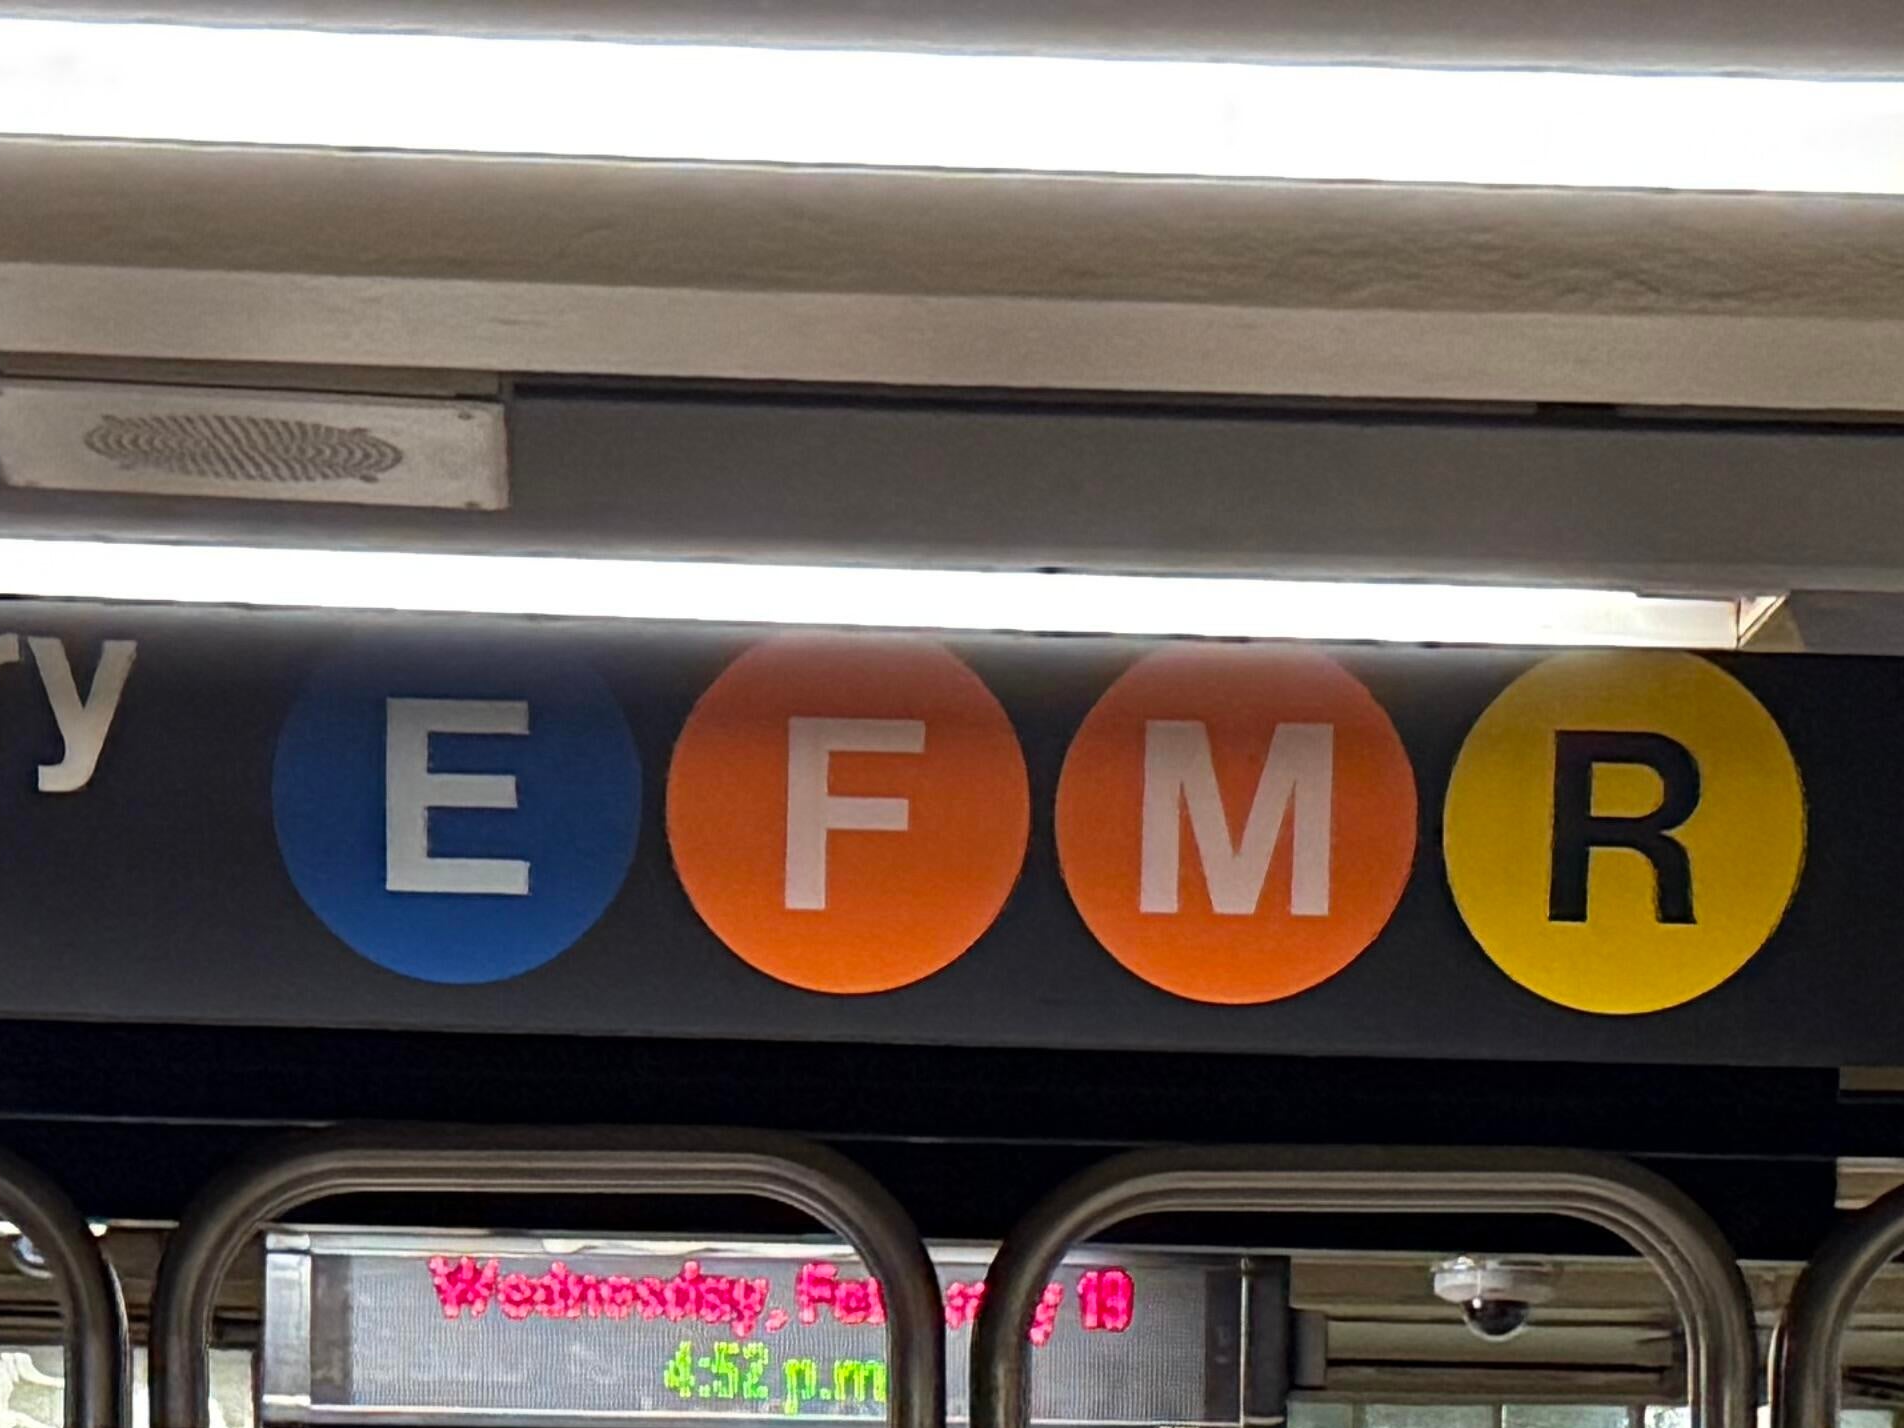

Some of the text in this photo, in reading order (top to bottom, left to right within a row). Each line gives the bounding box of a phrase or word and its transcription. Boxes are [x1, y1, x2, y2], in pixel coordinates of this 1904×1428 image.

[385, 697, 531, 895] E
[784, 716, 926, 911] F
[1139, 719, 1334, 916] M
[1548, 729, 1702, 925] R
[664, 1340, 769, 1398] 4:52
